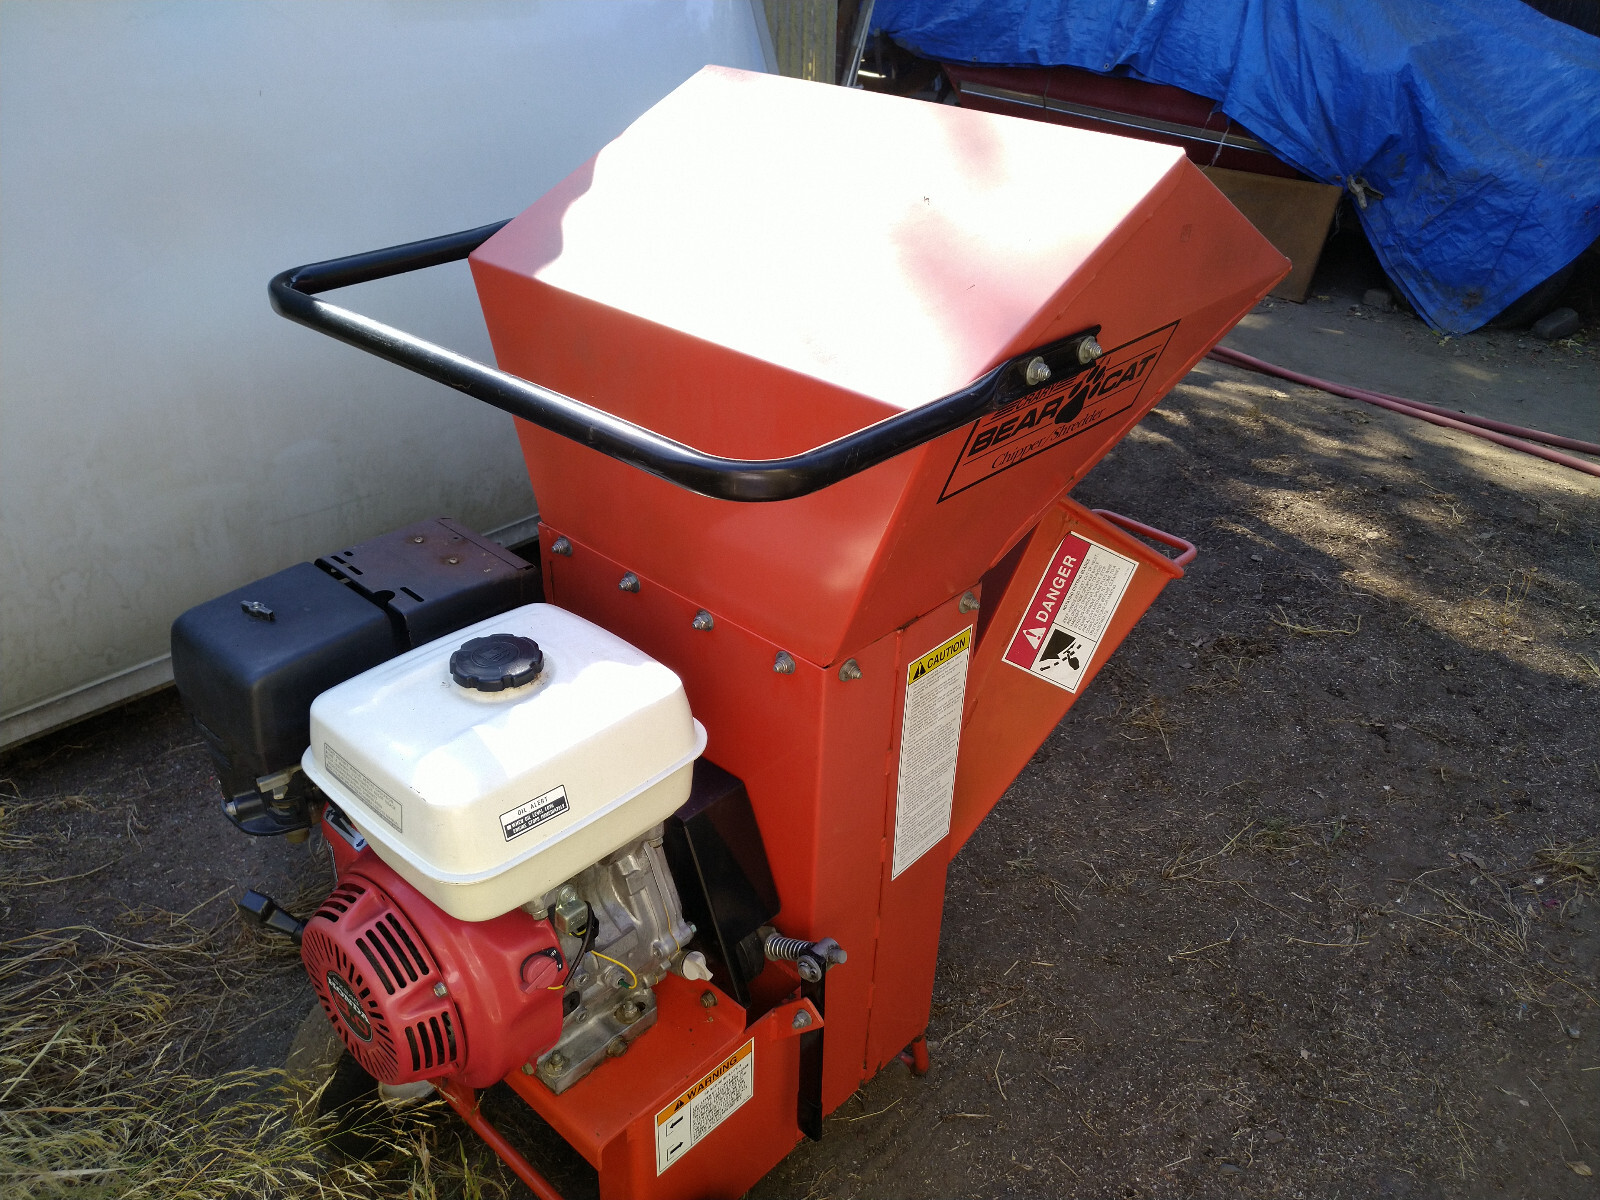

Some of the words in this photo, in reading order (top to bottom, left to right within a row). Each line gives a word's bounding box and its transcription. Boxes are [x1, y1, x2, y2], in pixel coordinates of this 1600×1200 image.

[967, 396, 1064, 457] BEAR
[1098, 353, 1156, 397] CAT
[991, 407, 1106, 469] Chipper/Shredder
[1036, 555, 1076, 622] DANGER
[927, 637, 965, 668] CAUTION
[530, 796, 548, 809] ALERT
[327, 977, 371, 1025] HONDA
[687, 1056, 737, 1100] WARNING
